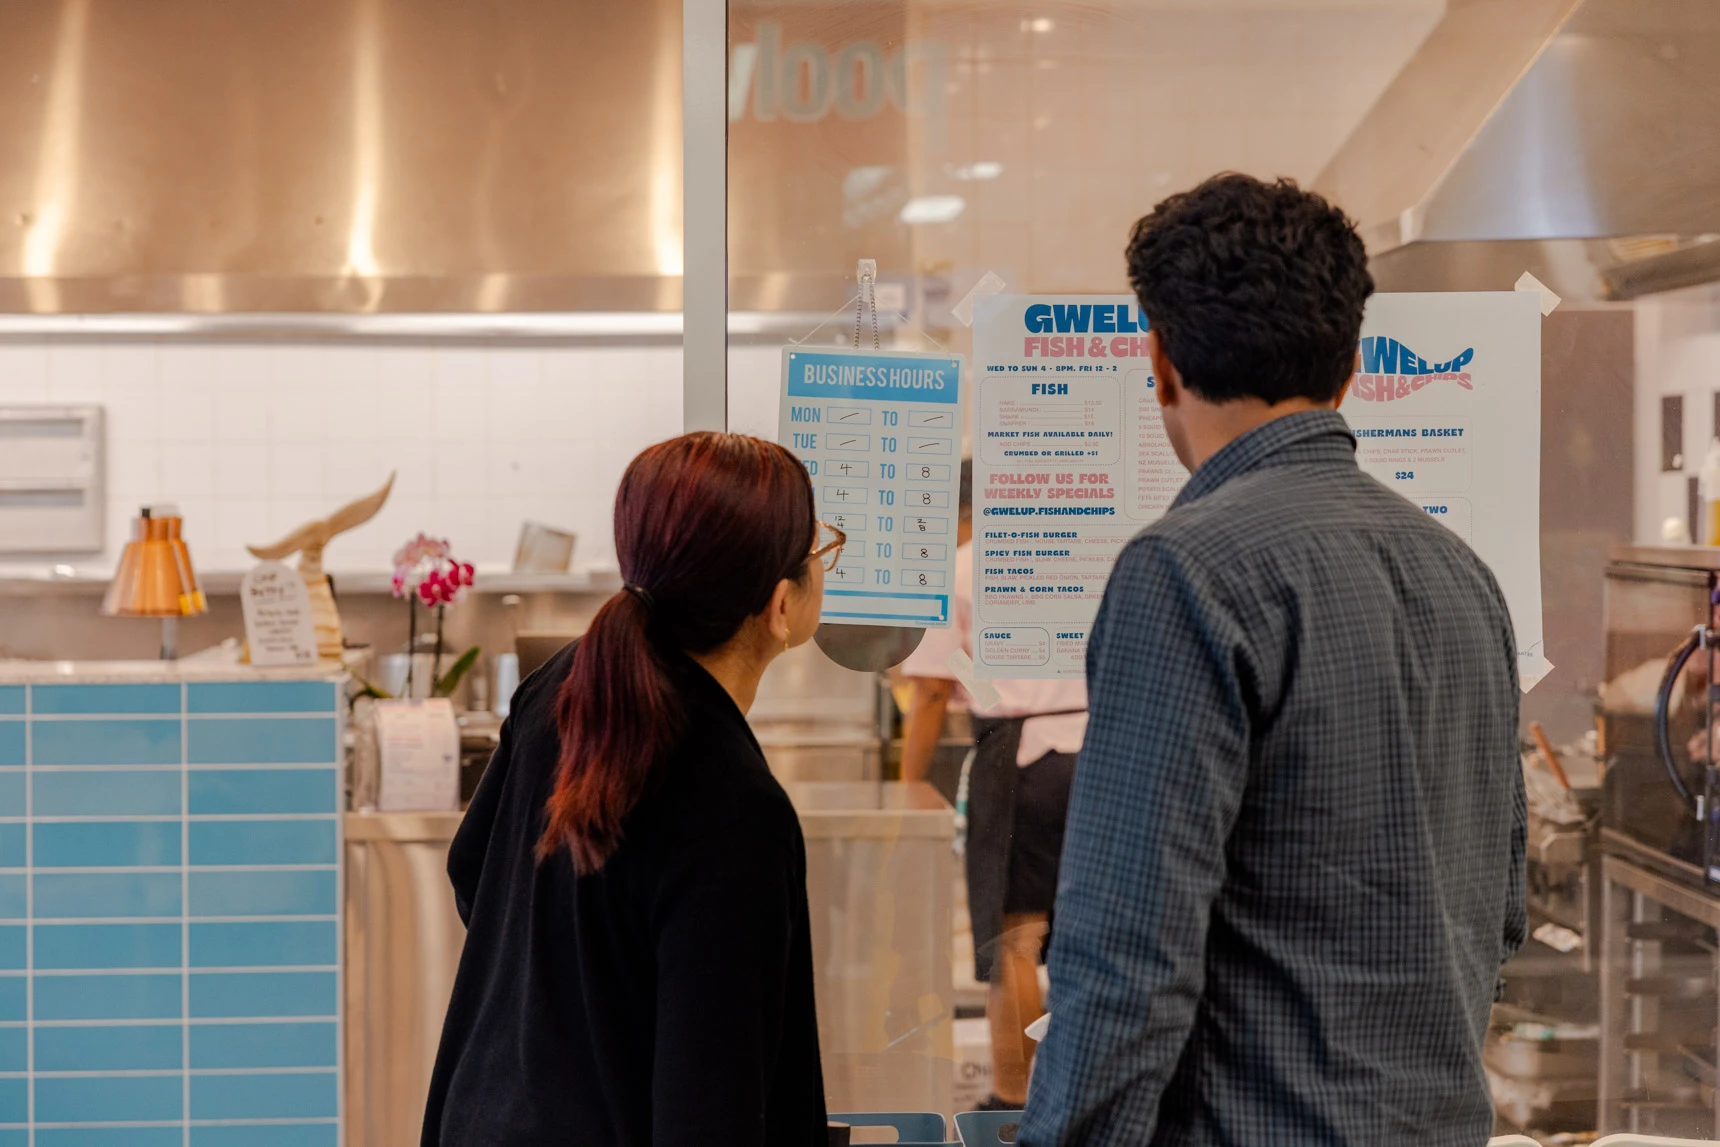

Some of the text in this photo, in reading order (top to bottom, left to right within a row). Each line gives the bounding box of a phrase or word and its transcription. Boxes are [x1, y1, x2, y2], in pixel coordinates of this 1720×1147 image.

[1024, 336, 1150, 358] FISH & CH
[1356, 336, 1474, 375] WELUP
[804, 364, 945, 390] BUSINESS HOURS
[1032, 383, 1068, 394] FISH
[1351, 373, 1395, 402] ISH
[791, 406, 898, 426] MON TO
[1352, 428, 1464, 437] ISHERMANS BASKET
[793, 433, 897, 452] TUE TO
[840, 464, 852, 475] 4
[880, 464, 895, 479] TO
[921, 466, 931, 478] 8
[1395, 471, 1414, 480] $24
[989, 474, 1109, 485] FOLLOW US FOR
[836, 489, 849, 501] 4
[878, 490, 894, 505] TO
[922, 492, 931, 505] 8
[984, 488, 1115, 499] WEEKLY SPECIALS
[983, 507, 1116, 516] @GWELUP.FISHANDCHIPS
[1422, 506, 1448, 514] TWO
[877, 516, 893, 532] TO
[876, 542, 892, 558] TO
[920, 548, 928, 558] 8
[836, 568, 846, 579] 4
[875, 568, 891, 584] TO
[919, 574, 927, 585] 8
